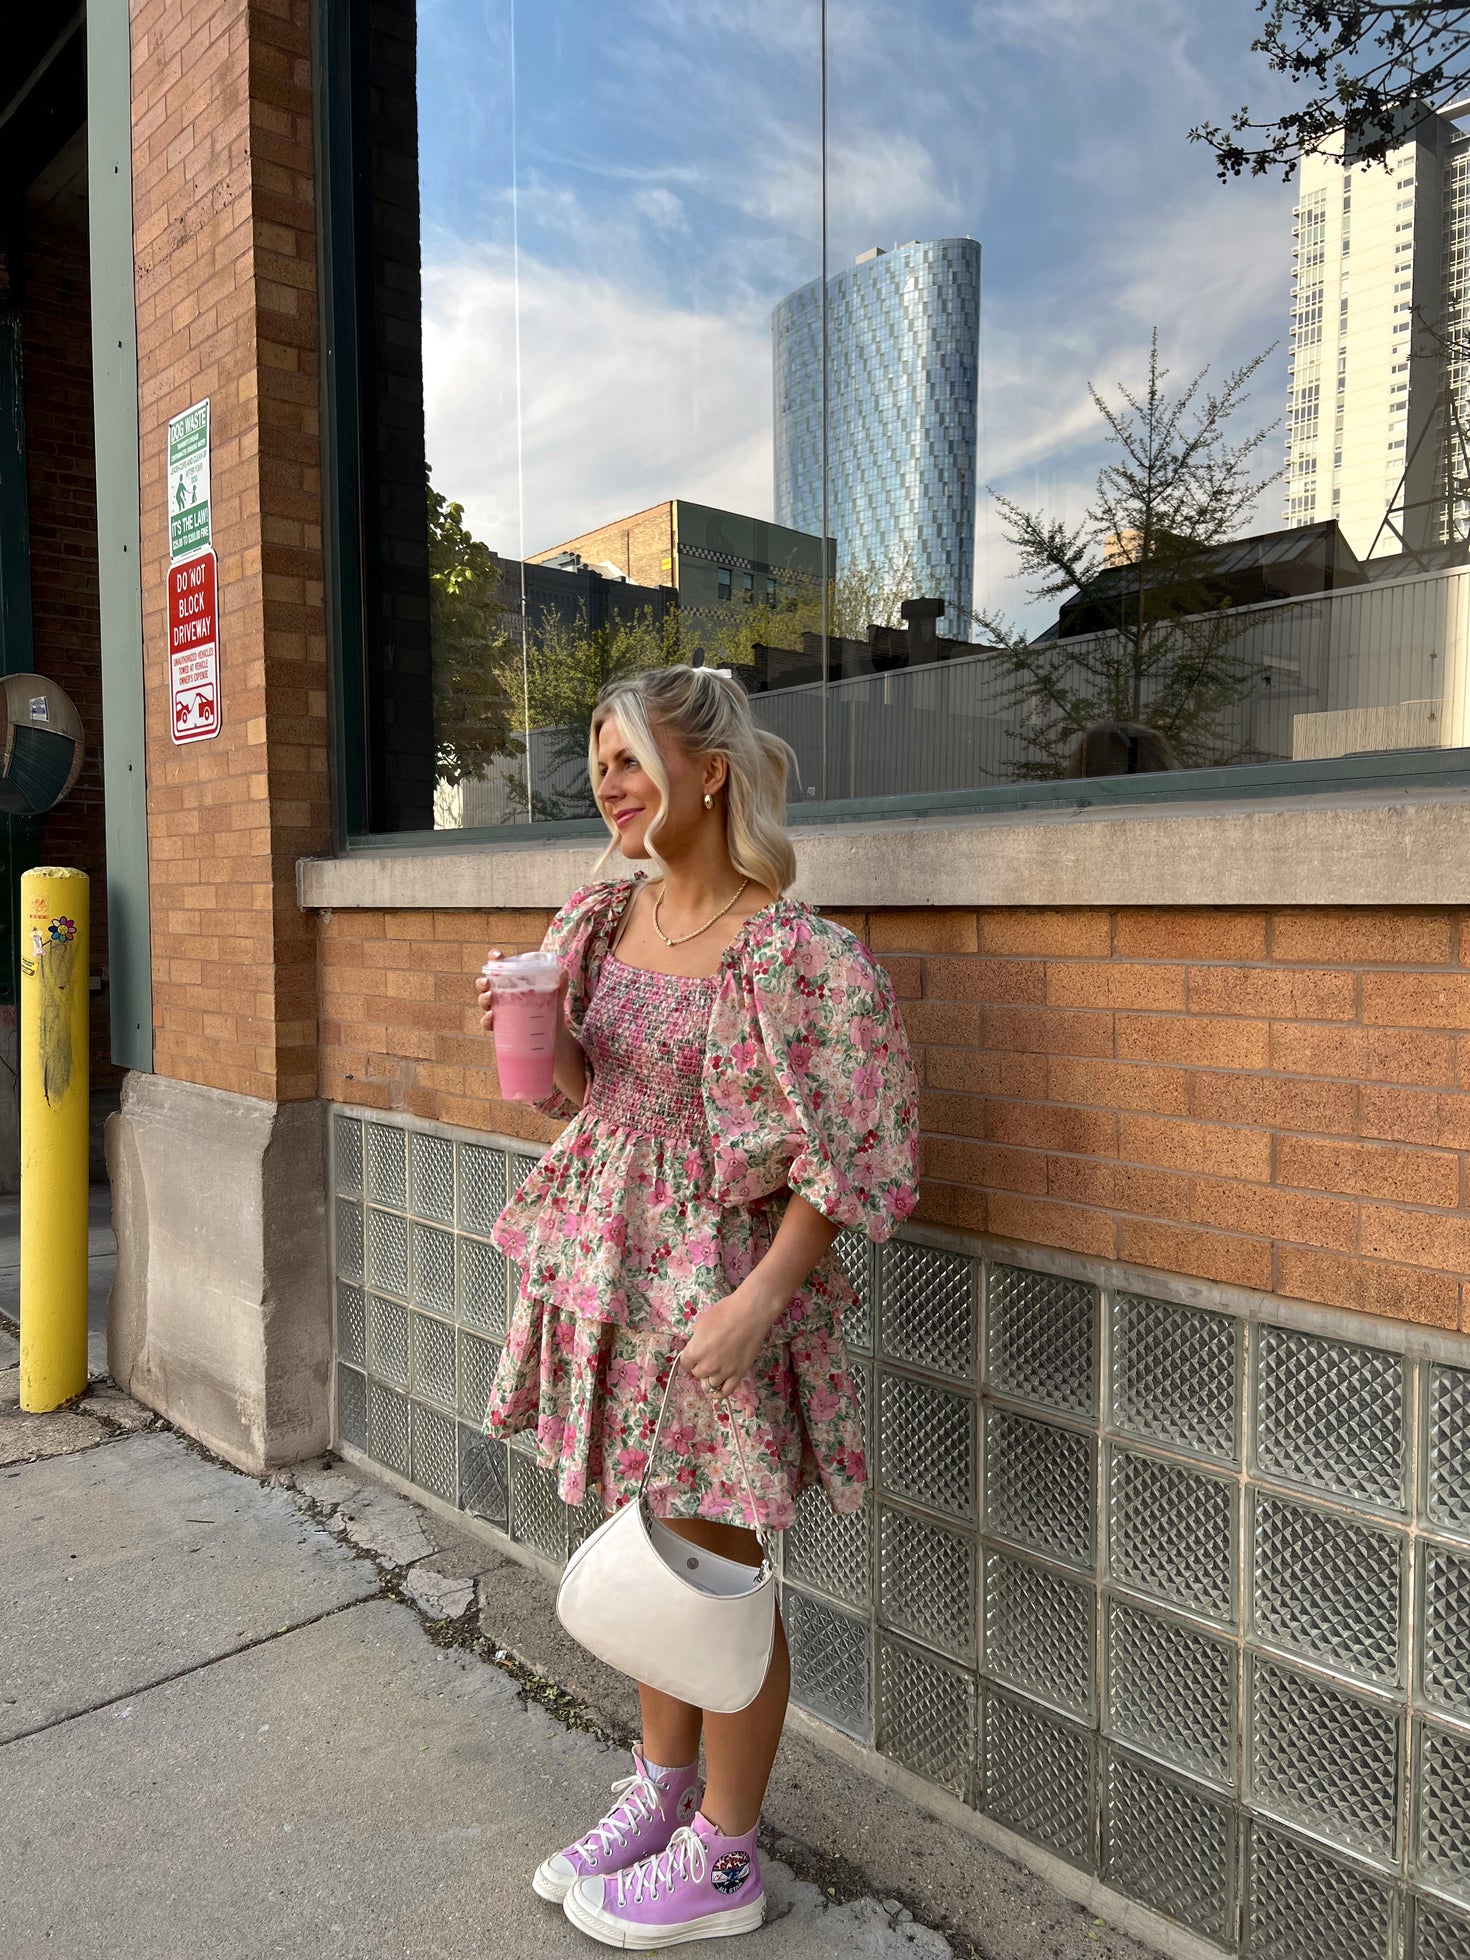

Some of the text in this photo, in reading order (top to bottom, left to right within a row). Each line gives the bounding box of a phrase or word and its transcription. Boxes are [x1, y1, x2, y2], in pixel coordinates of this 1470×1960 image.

[171, 421, 184, 442] DOG
[185, 407, 206, 432] WASTE
[182, 514, 193, 532] THE
[200, 526, 209, 538] FINE
[177, 563, 206, 593] DO NOT
[179, 591, 205, 619] BLOCK
[173, 615, 211, 646] DRIVEWAY
[190, 663, 194, 671] AT
[195, 660, 208, 670] VEHICLE
[198, 648, 213, 660] VEHICLES
